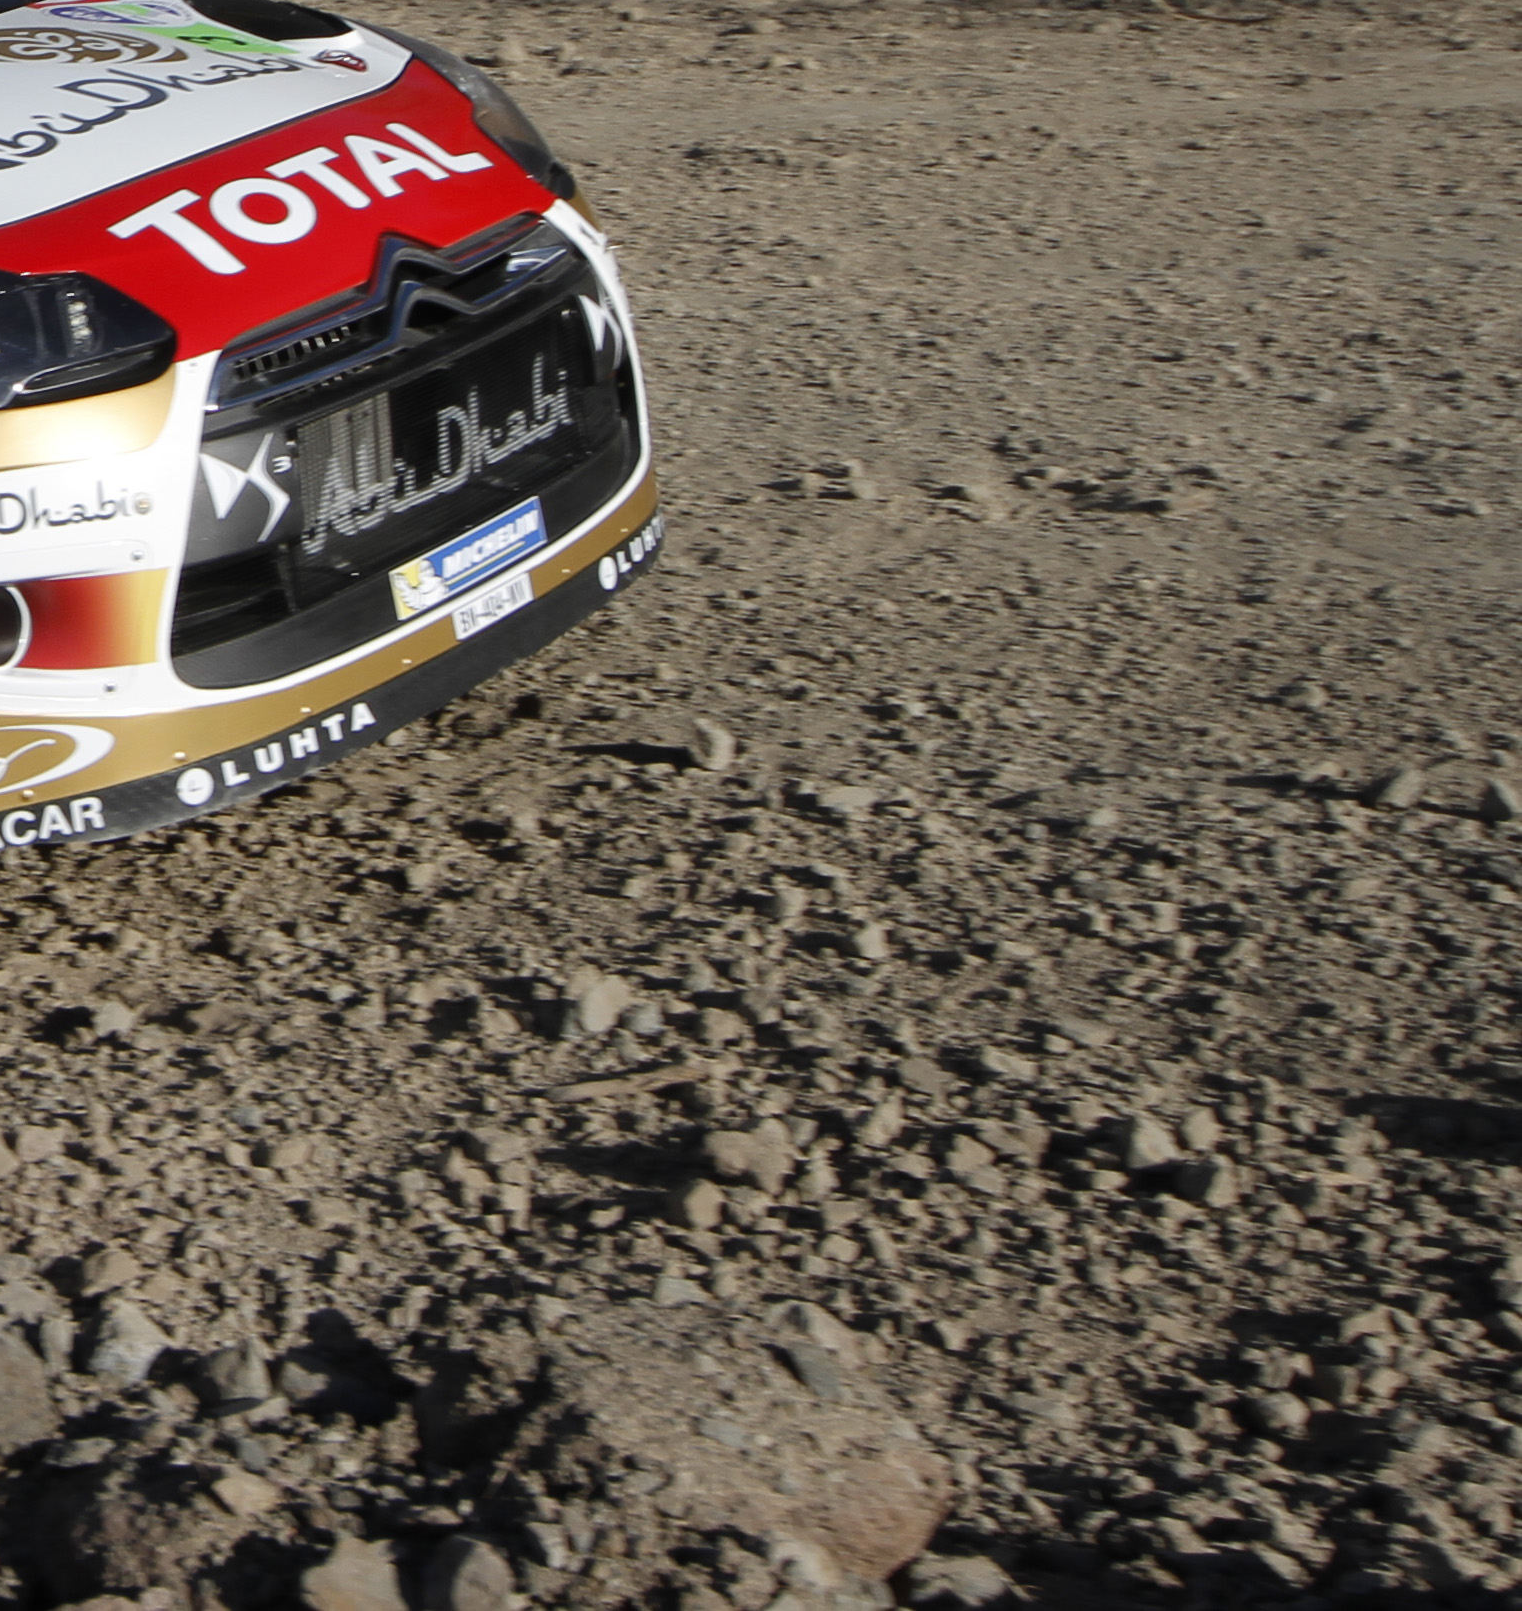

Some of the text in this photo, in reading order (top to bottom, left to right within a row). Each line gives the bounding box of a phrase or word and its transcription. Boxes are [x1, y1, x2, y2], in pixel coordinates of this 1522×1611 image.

[108, 123, 494, 275] TOTAL
[443, 509, 539, 578] MICHELIN
[220, 702, 376, 787] LUHTA
